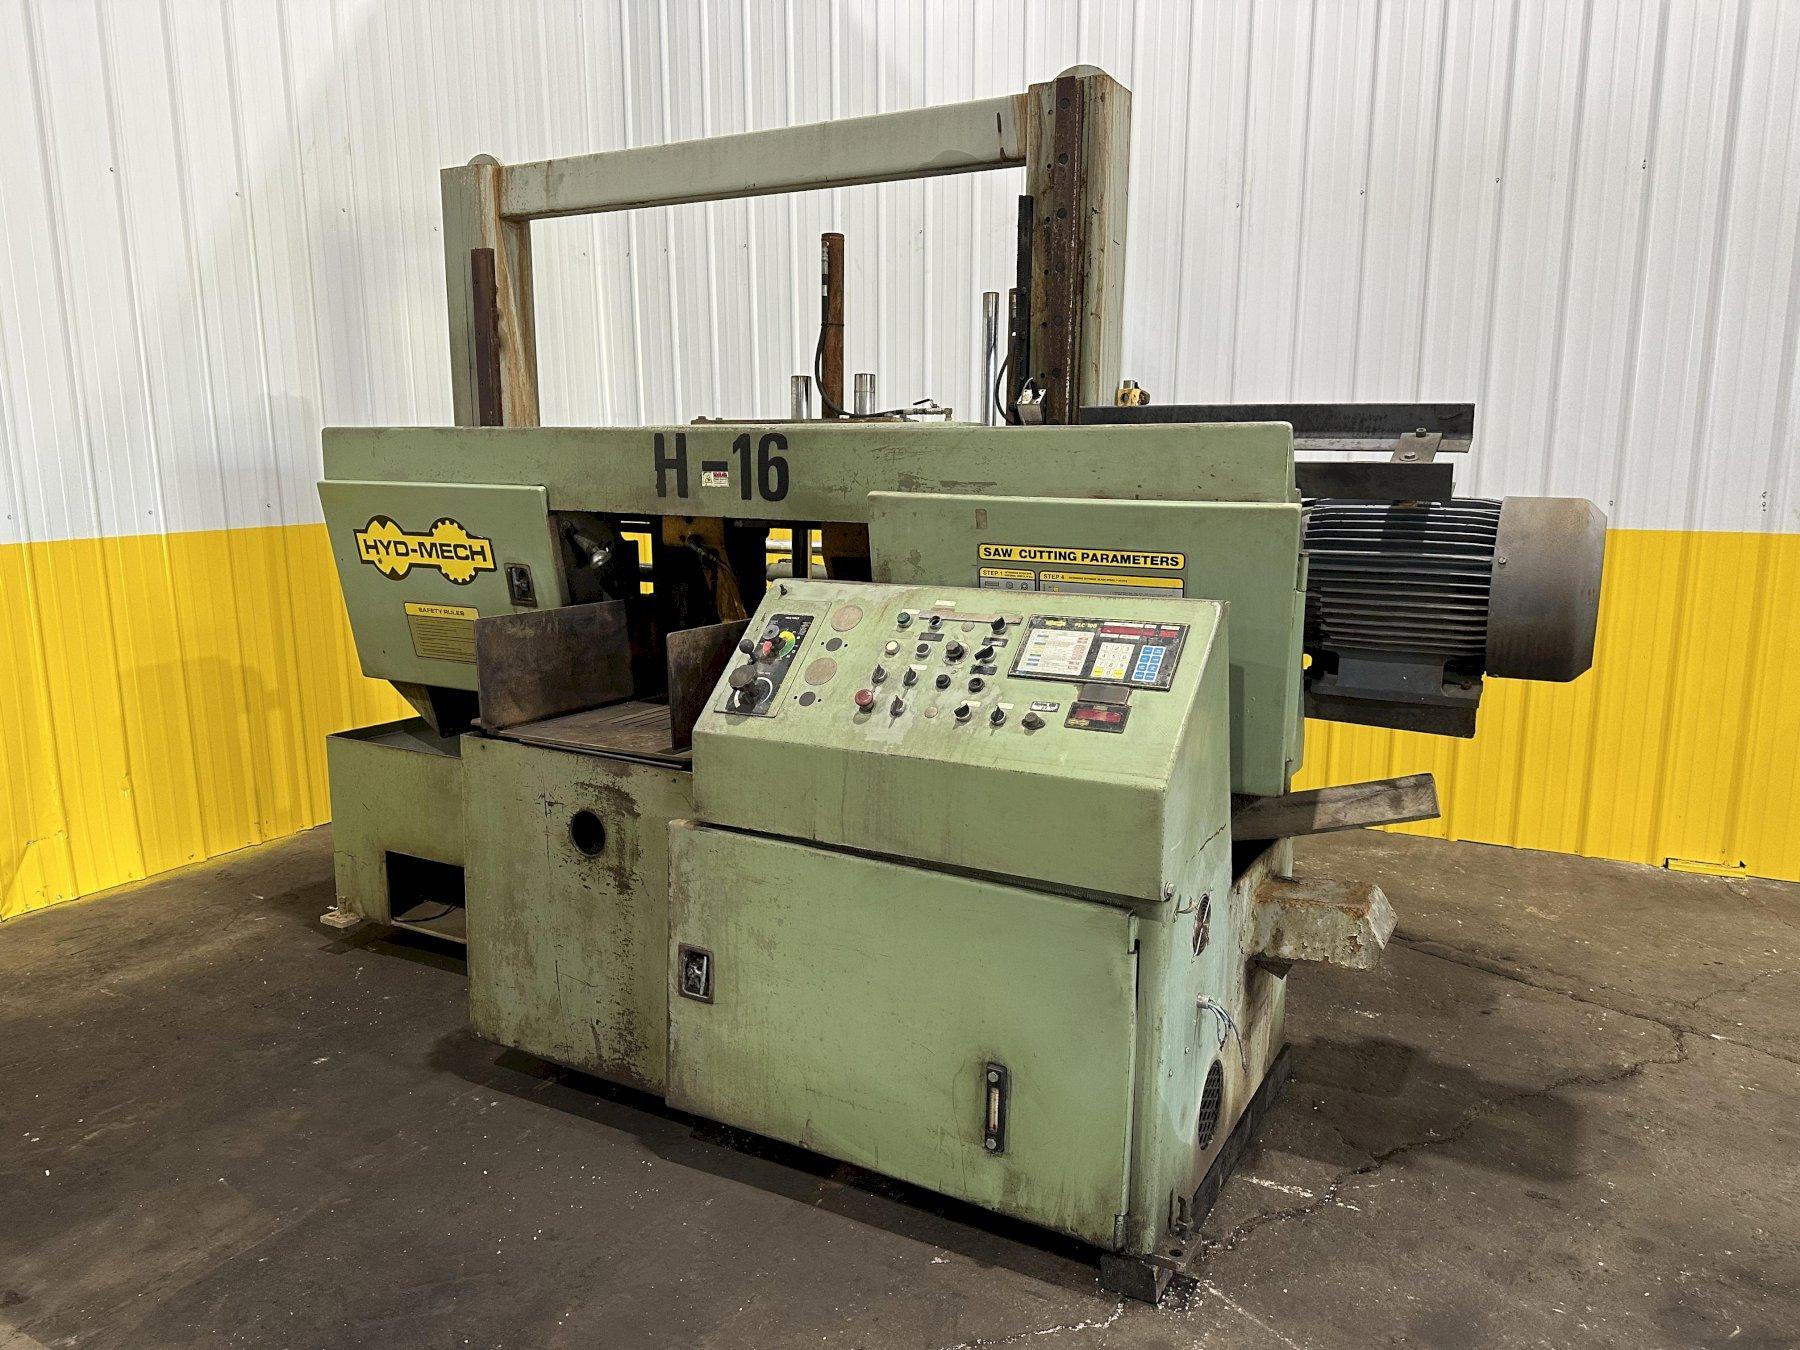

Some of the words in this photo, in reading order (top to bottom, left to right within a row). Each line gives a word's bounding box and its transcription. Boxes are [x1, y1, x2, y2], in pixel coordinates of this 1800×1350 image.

[362, 538, 488, 562] HYD-MECH
[983, 547, 1013, 558] SAW
[1018, 549, 1077, 562] CUTTING
[1080, 552, 1180, 567] PARAMETERS
